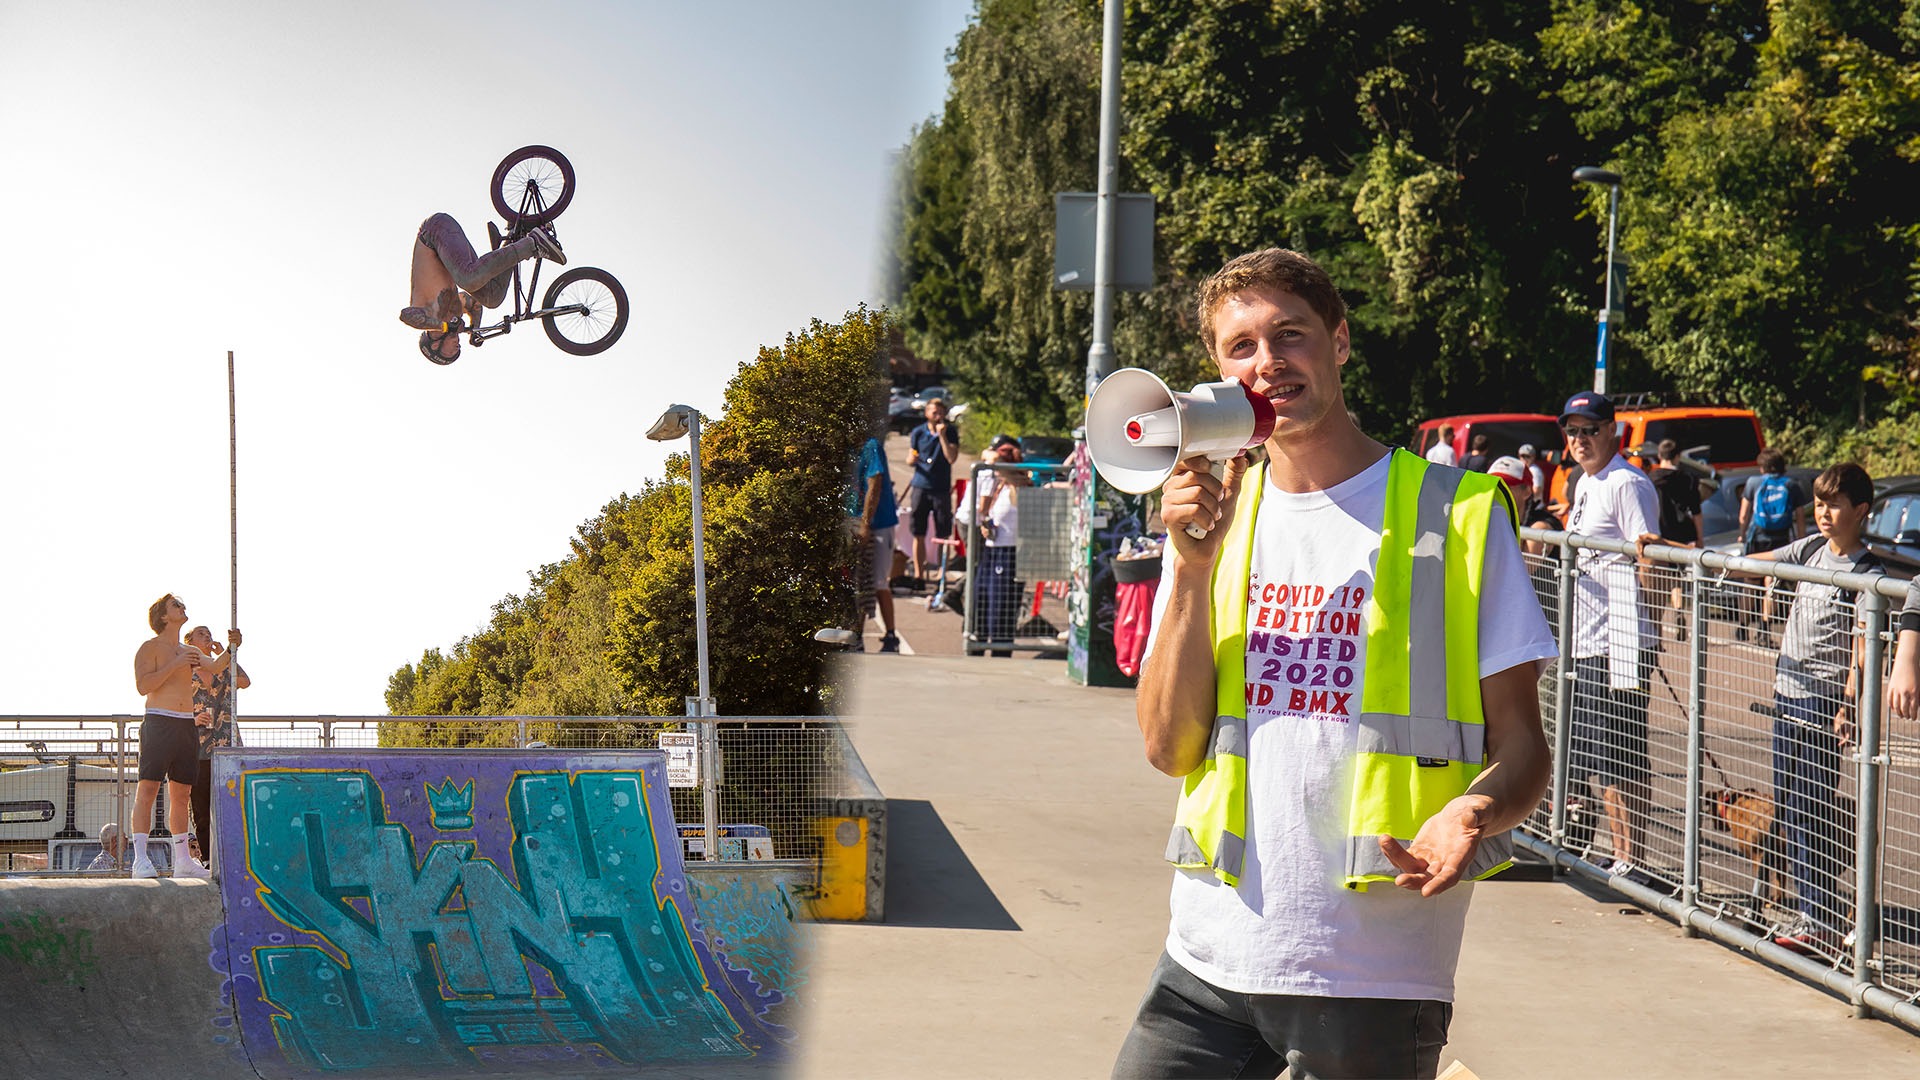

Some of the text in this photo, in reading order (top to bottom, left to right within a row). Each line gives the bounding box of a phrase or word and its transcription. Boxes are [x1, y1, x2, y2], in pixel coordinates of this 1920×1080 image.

[1262, 582, 1365, 609] COVID-19
[1256, 606, 1361, 636] EDITION
[1247, 631, 1357, 662] NSTED
[1260, 658, 1354, 688] 2020
[1245, 682, 1352, 715] ND BMX
[1330, 716, 1350, 724] HOME
[662, 737, 694, 745] BE SAFE
